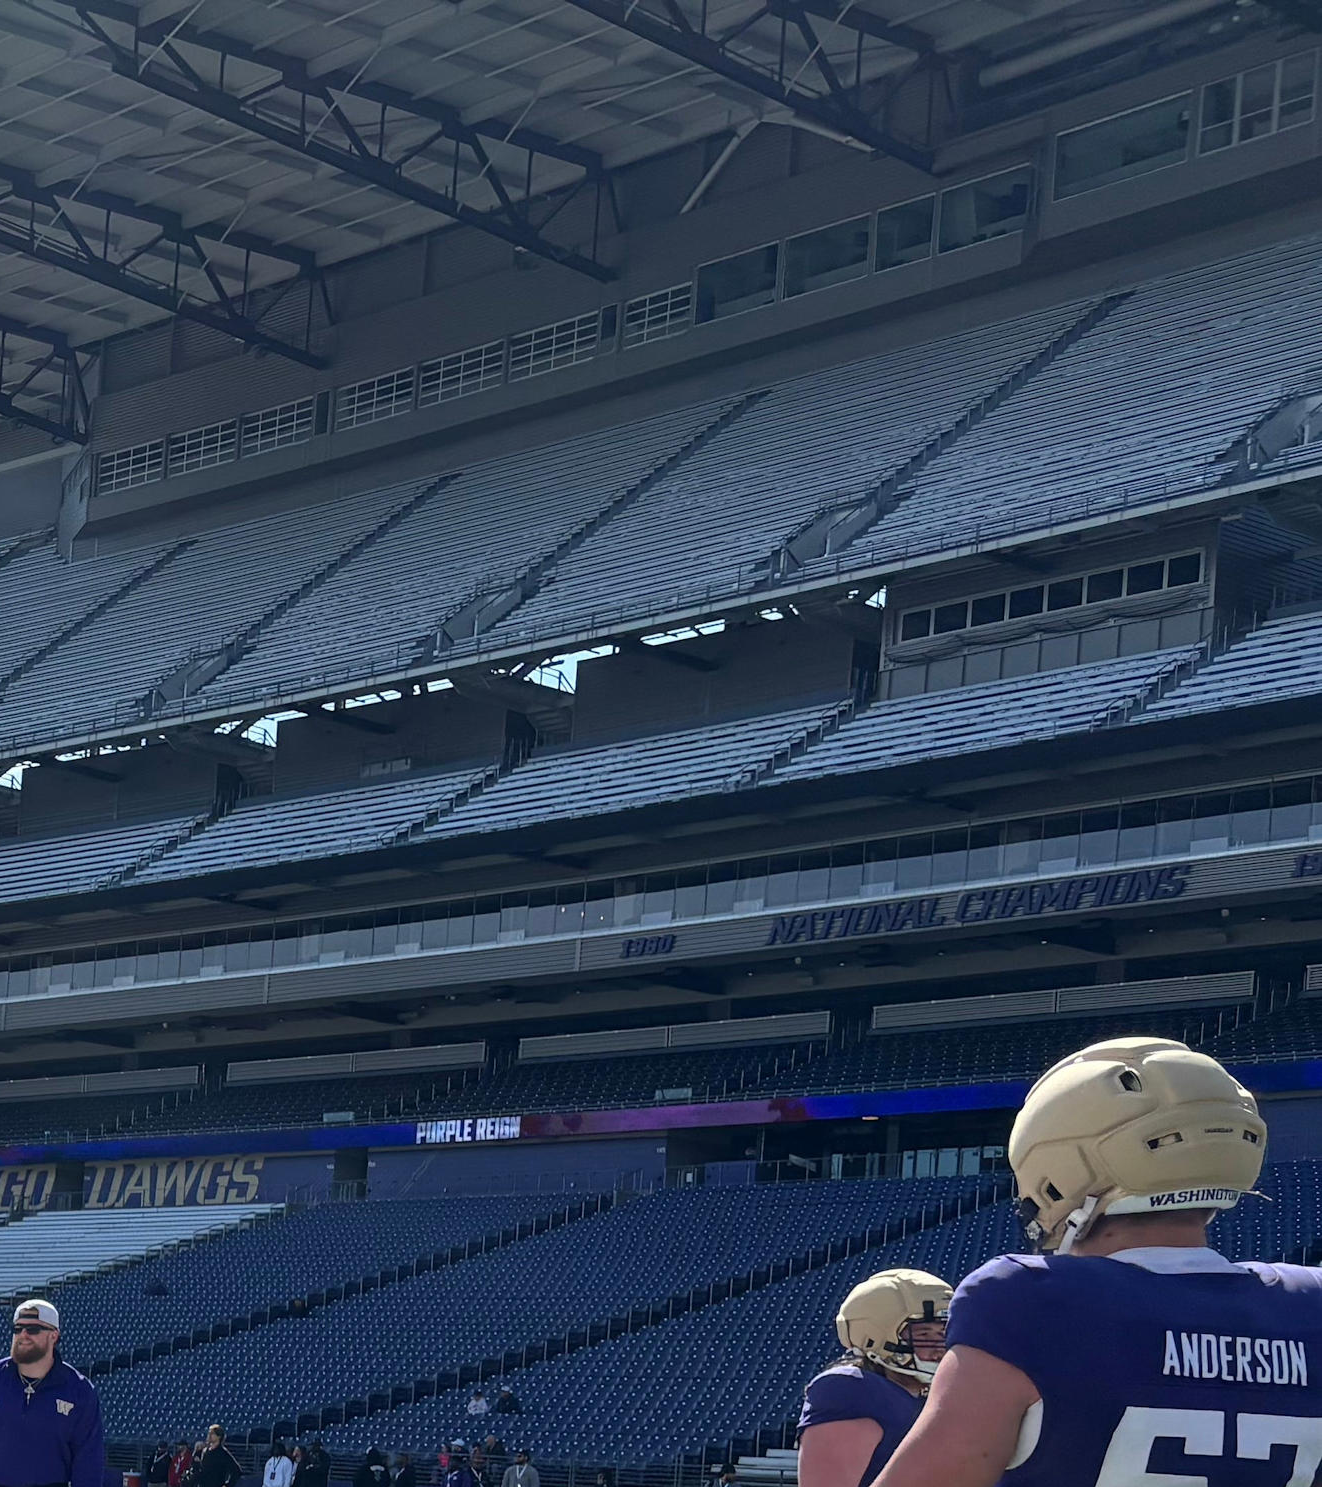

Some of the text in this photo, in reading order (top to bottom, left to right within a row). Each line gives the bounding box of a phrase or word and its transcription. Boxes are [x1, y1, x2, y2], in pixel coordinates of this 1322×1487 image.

[766, 896, 946, 948] NATIONAL
[955, 863, 1192, 925] CHAMPIONS
[416, 1116, 522, 1144] PURPLE REIGN
[84, 1155, 265, 1211] DAWGS
[1149, 1188, 1240, 1207] WASHINGTON
[1162, 1329, 1308, 1388] ANDERSON
[56, 1399, 75, 1416] W
